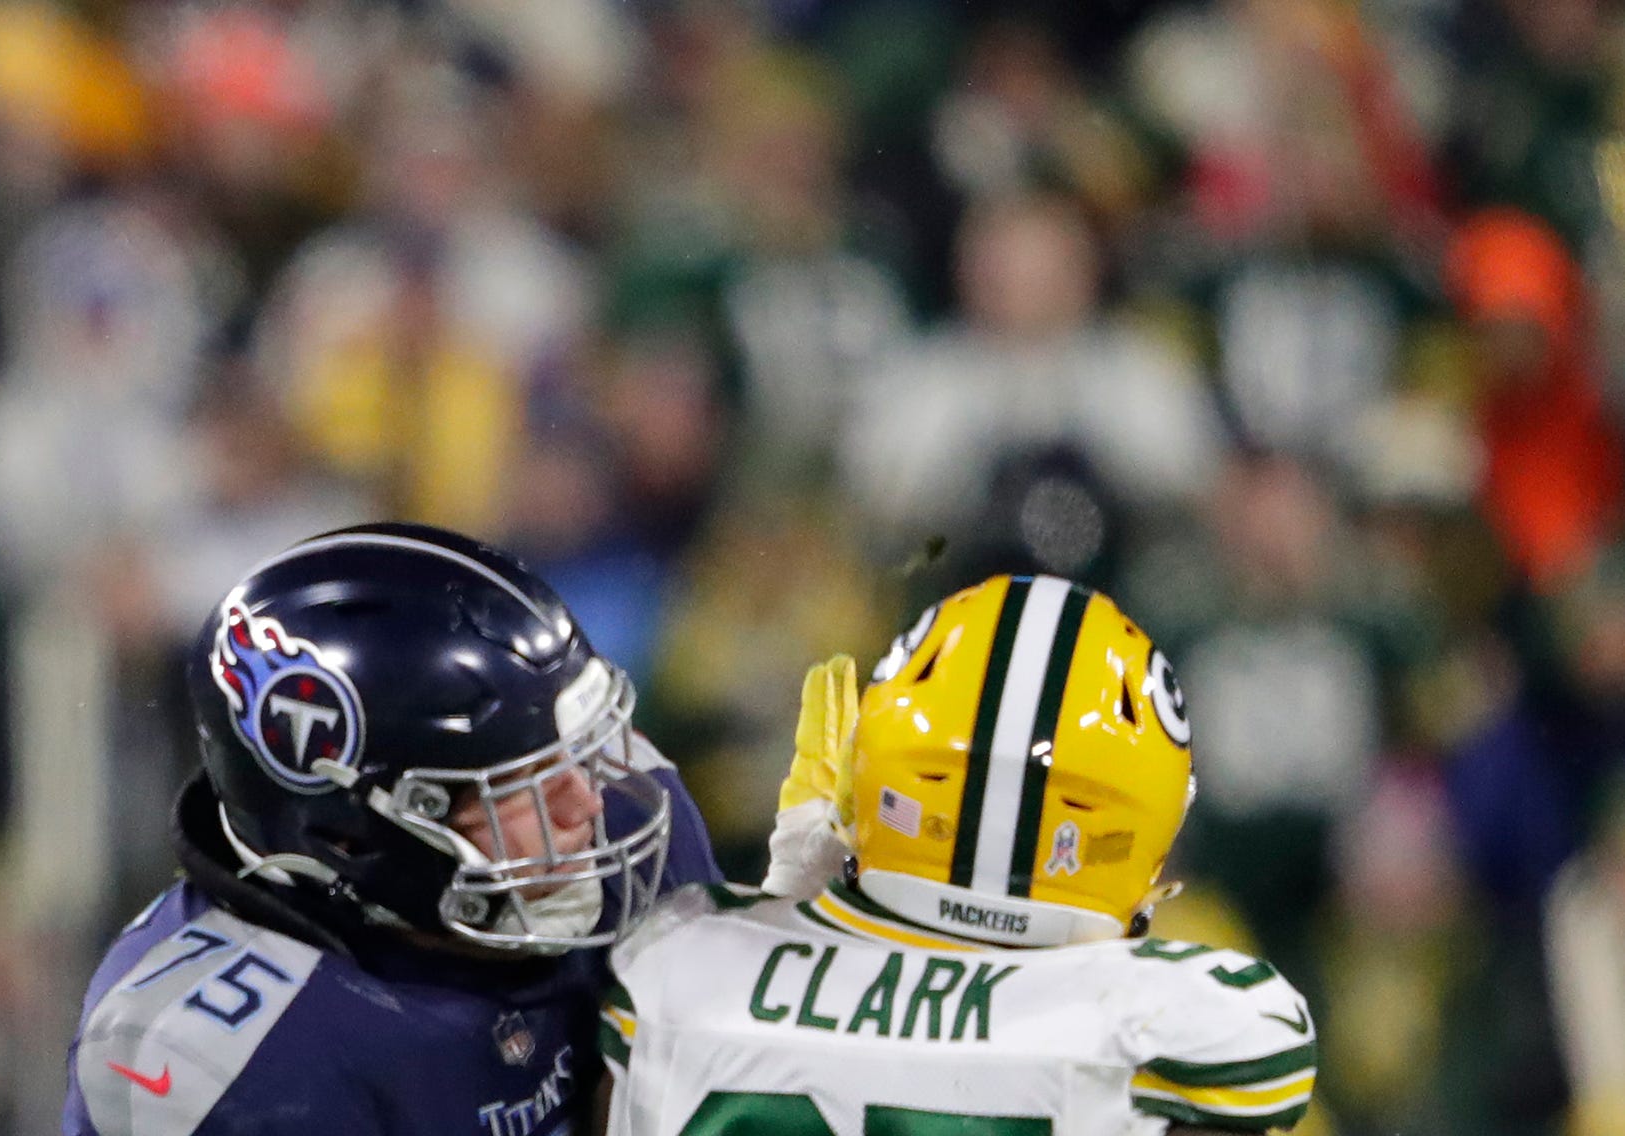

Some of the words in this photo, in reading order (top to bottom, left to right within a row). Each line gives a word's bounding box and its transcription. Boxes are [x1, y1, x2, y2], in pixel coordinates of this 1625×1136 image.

[938, 898, 1030, 935] PACKERS
[131, 928, 297, 1033] 75
[749, 941, 1023, 1043] CLARK
